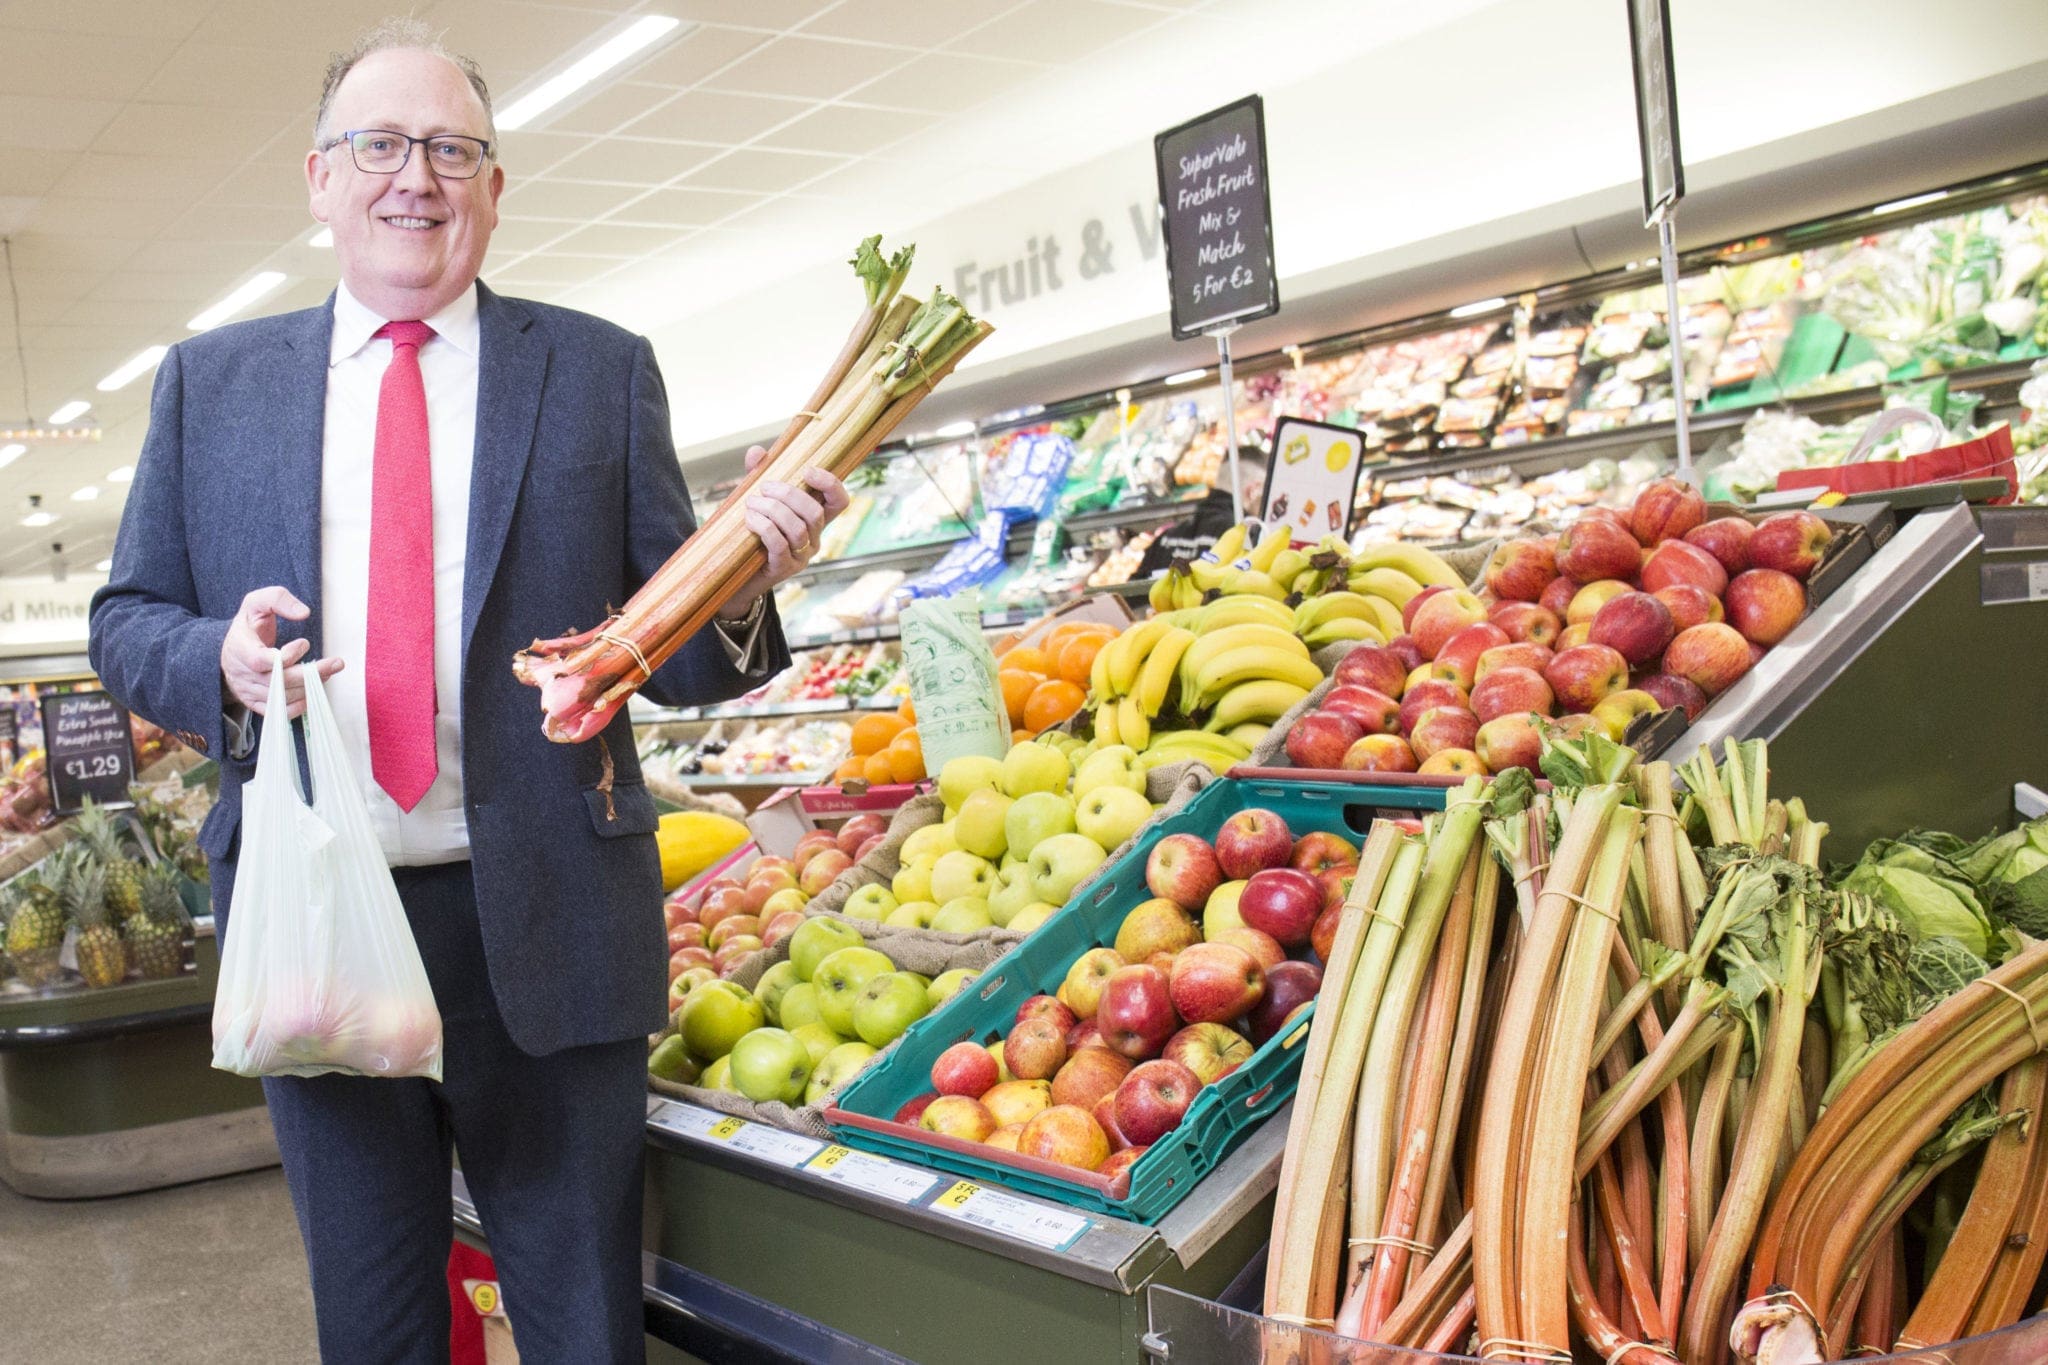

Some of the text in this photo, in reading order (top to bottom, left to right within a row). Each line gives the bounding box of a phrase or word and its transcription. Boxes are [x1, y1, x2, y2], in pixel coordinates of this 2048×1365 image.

[1178, 165, 1255, 211] Fresh Fruit
[1199, 207, 1241, 234] Mix &
[954, 198, 1163, 312] Fruit & V
[1199, 231, 1245, 266] Match
[1193, 265, 1254, 303] 5 For €2
[25, 601, 86, 621] Mine
[58, 717, 87, 731] Extra
[65, 753, 121, 780] €1.29
